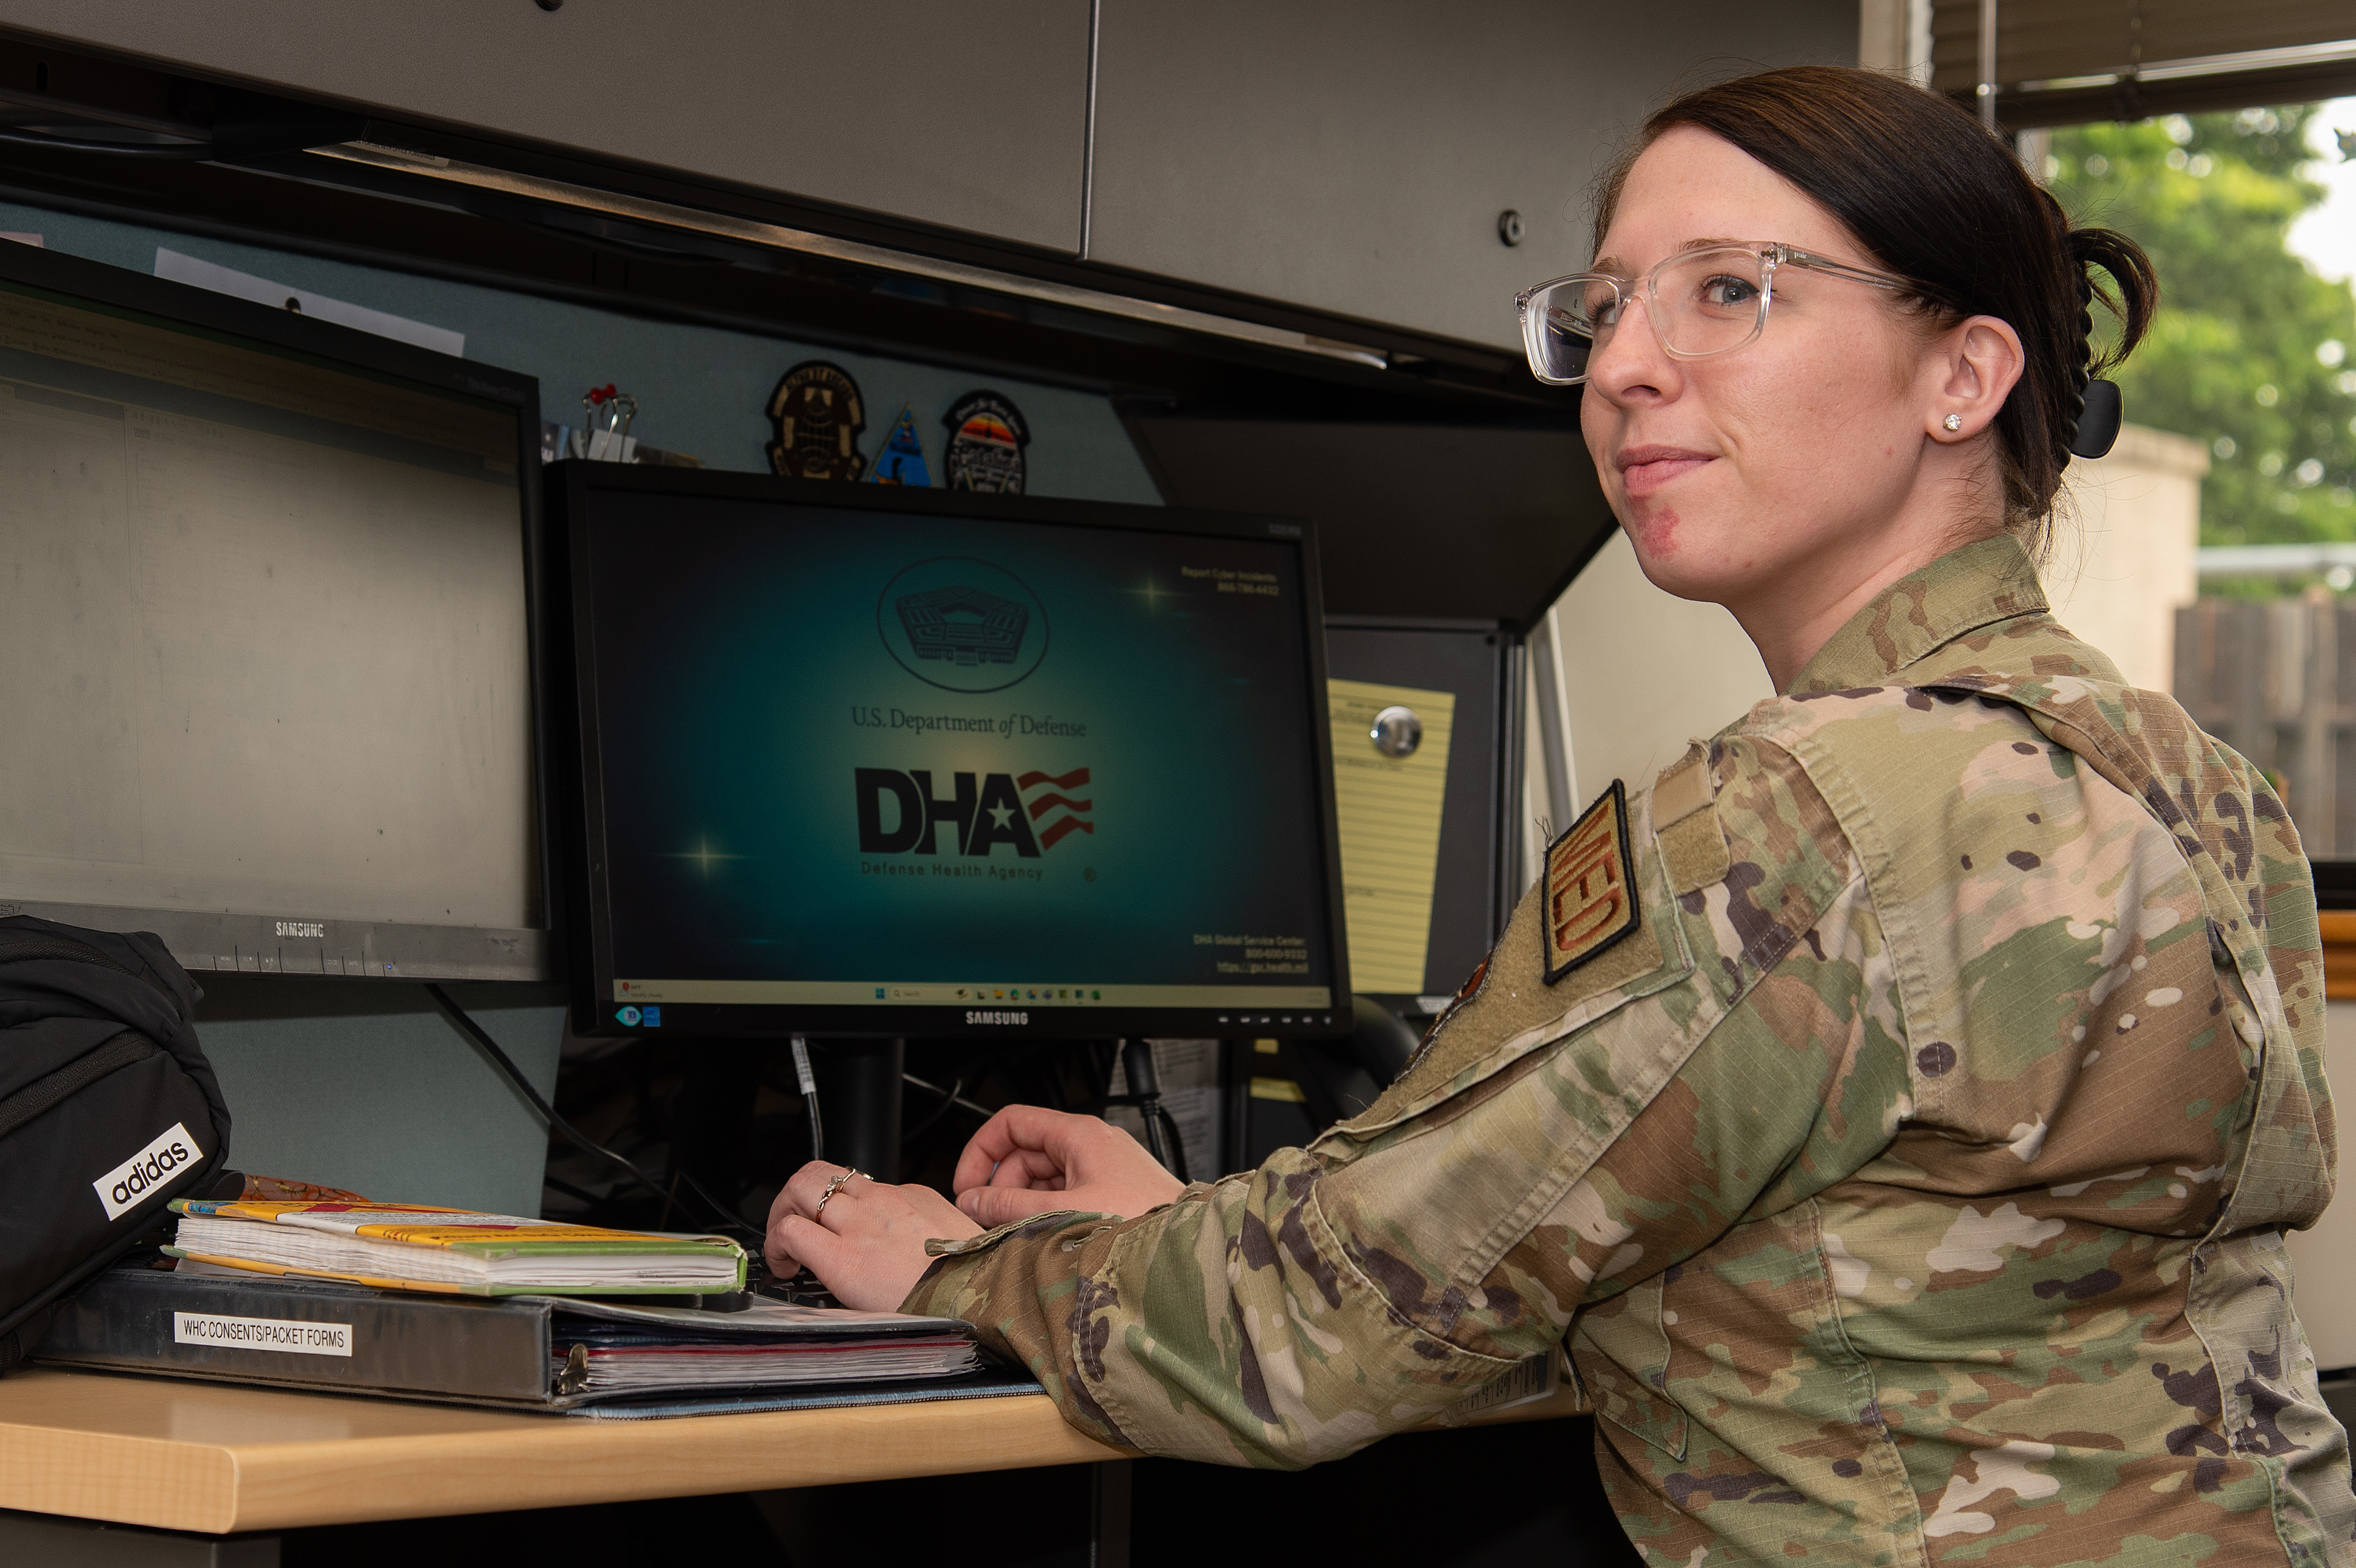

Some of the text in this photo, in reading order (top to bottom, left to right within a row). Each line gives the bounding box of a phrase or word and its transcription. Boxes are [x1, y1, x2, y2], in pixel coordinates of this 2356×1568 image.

[852, 707, 1086, 739] U.S. Department of Defense
[855, 767, 1041, 858] DHA
[861, 861, 1043, 881] Defense Health Agency
[1552, 805, 1620, 951] MED
[276, 922, 324, 938] SAMSUNG
[1193, 934, 1213, 945] DHA
[1215, 934, 1242, 946] Global
[1244, 935, 1274, 946] Service
[966, 1010, 1028, 1026] SAMSUNG
[112, 1141, 189, 1205] adidas
[184, 1319, 344, 1348] WHC CONSENTS/PACKET FORMS
